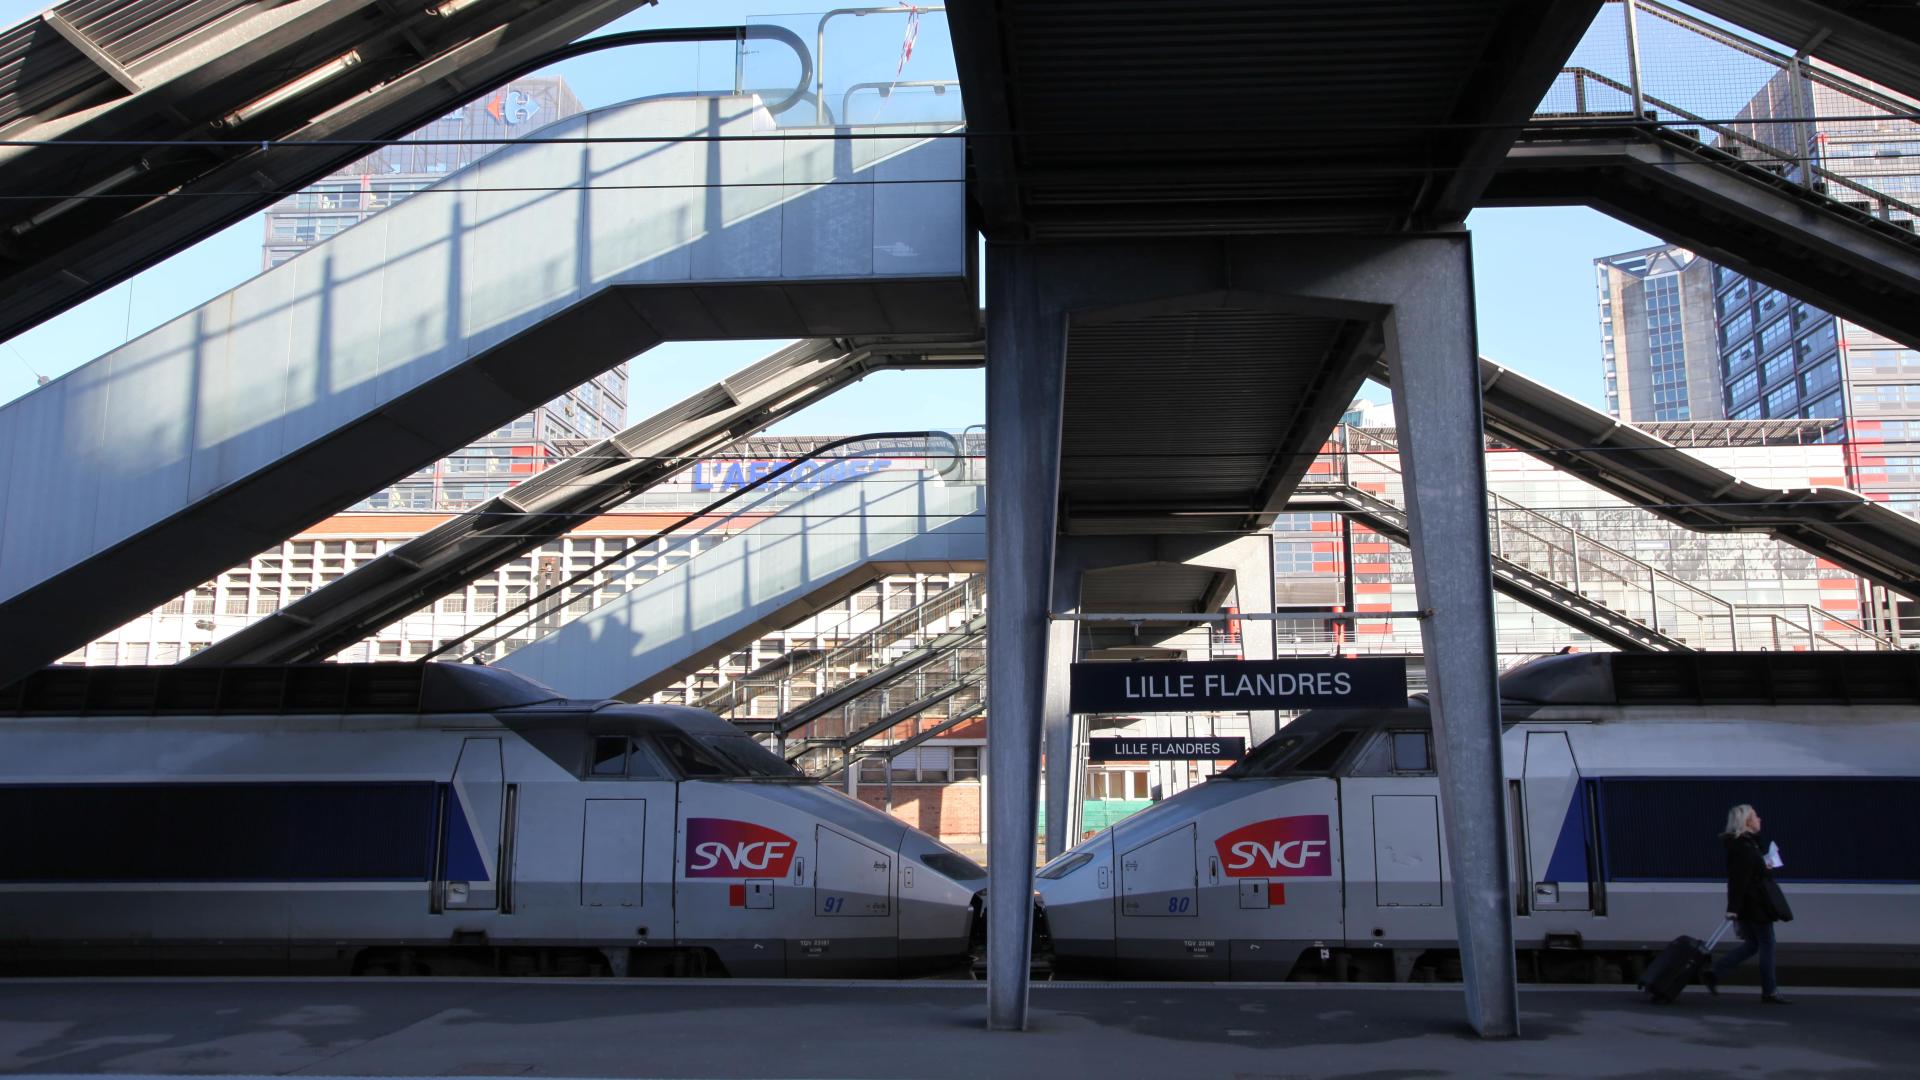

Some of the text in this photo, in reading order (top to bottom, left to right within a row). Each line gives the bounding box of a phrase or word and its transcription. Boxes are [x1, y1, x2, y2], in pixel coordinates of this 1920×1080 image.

[1125, 672, 1352, 699] LILLE FLANDRES
[1115, 742, 1221, 755] LILLE FLANDRES
[690, 841, 791, 870] SNCF
[1228, 840, 1327, 869] SNCF
[823, 897, 844, 913] 91
[1168, 897, 1190, 913] 80
